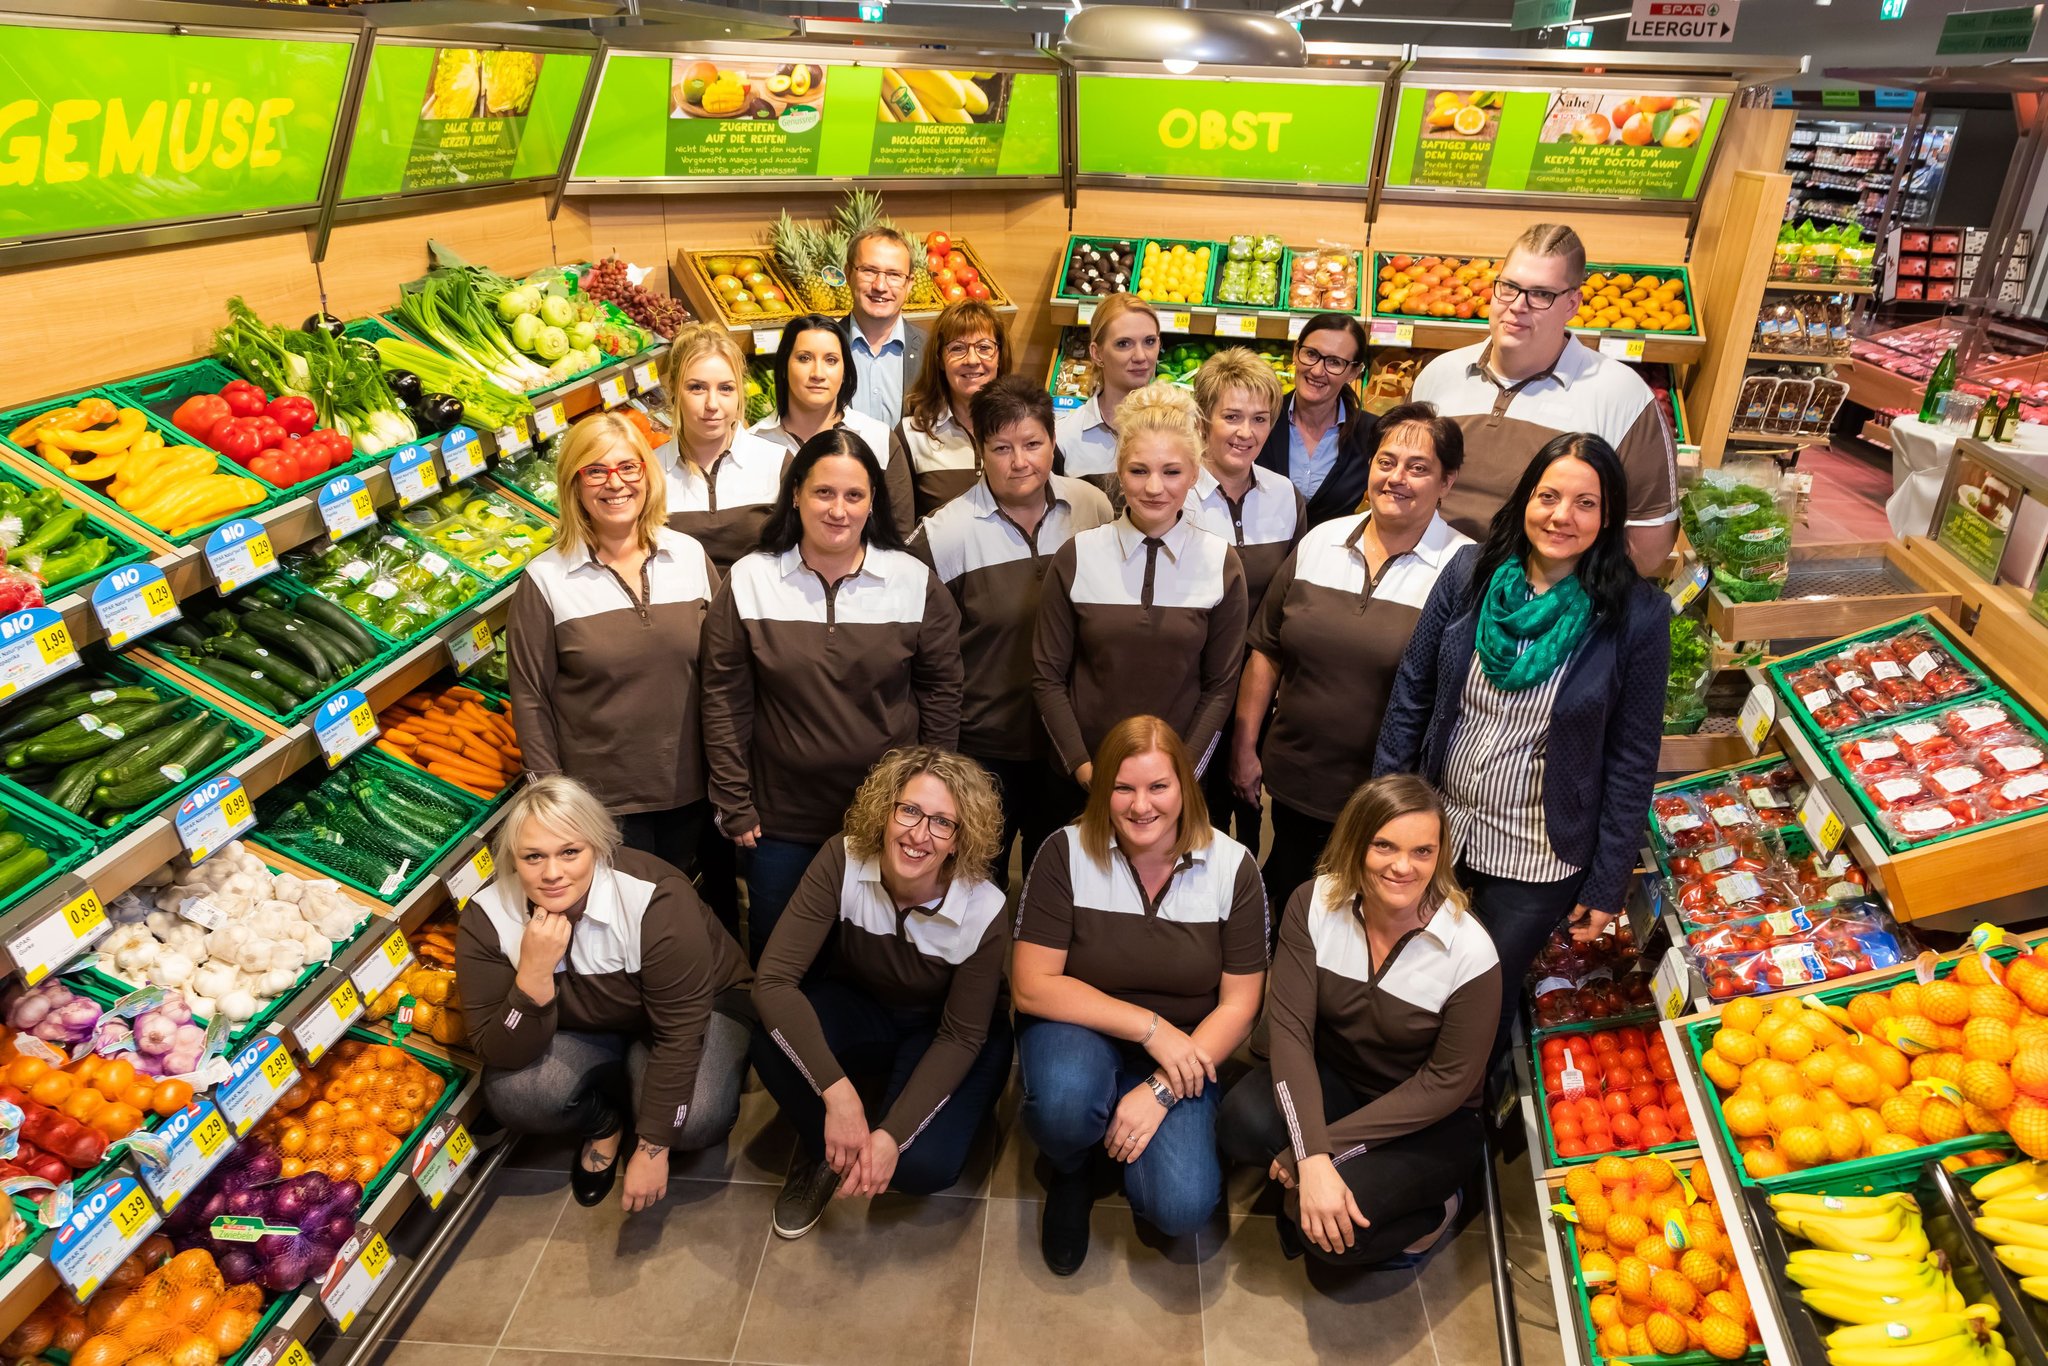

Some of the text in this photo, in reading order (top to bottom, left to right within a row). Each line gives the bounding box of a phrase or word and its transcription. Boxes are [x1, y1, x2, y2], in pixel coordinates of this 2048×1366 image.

[1662, 4, 1705, 15] SPAR
[1631, 21, 1718, 38] LEERGUT
[0, 82, 295, 187] GEMÜSE
[471, 121, 485, 133] DER
[488, 121, 503, 132] VON
[719, 122, 775, 133] ZUGREIFEN
[1158, 108, 1293, 154] OBST
[440, 134, 499, 148] HERZEN KOMMT
[705, 134, 787, 144] AUF DIE REIFEN!
[891, 136, 986, 145] BIOLOGISCH VERPACKT!
[1421, 140, 1491, 151] SAFTIGES AUS
[675, 145, 784, 155] Nicht länger warten mit den
[1425, 150, 1483, 161] DEM SÜDEN
[1569, 146, 1661, 158] AN APPLE A DAY
[681, 155, 727, 165] Vorgereifte
[760, 156, 773, 164] und
[775, 156, 809, 164] Avocados
[1544, 155, 1681, 169] KEEPS THE DOCTOR AWAY
[688, 166, 797, 176] können Sie sofort geniessen!
[1567, 167, 1593, 176] besagt
[1058, 397, 1074, 406] BIO
[450, 429, 466, 445] BIO
[399, 447, 416, 464] BIO
[330, 478, 350, 497] BIO
[355, 494, 370, 510] 1,29
[221, 523, 245, 543] BIO
[252, 540, 269, 557] 1,29
[111, 568, 140, 591] BIO
[148, 585, 169, 605] 1,29
[0, 613, 34, 639] BIO
[42, 629, 66, 652] 1,99
[327, 695, 349, 717] BIO
[354, 708, 371, 727] 2,49
[193, 783, 220, 809] BIO
[225, 794, 246, 816] 0,99
[70, 898, 97, 924] 0,89
[15, 936, 31, 950] SPAR
[19, 942, 35, 956] Gurke
[388, 936, 404, 956] 1,99
[336, 987, 354, 1009] 1,49
[232, 1047, 259, 1078] BIO
[267, 1052, 288, 1078] 2,99
[159, 1113, 189, 1144] BIO
[199, 1118, 222, 1146] 1,29
[451, 1132, 468, 1154] 1,79
[72, 1193, 107, 1231] BIO
[120, 1196, 146, 1227] 1,39
[218, 1230, 254, 1240] Zwiebeln
[64, 1250, 80, 1267] SPAR
[68, 1252, 88, 1273] Zwiebel
[366, 1240, 385, 1267] 1,49
